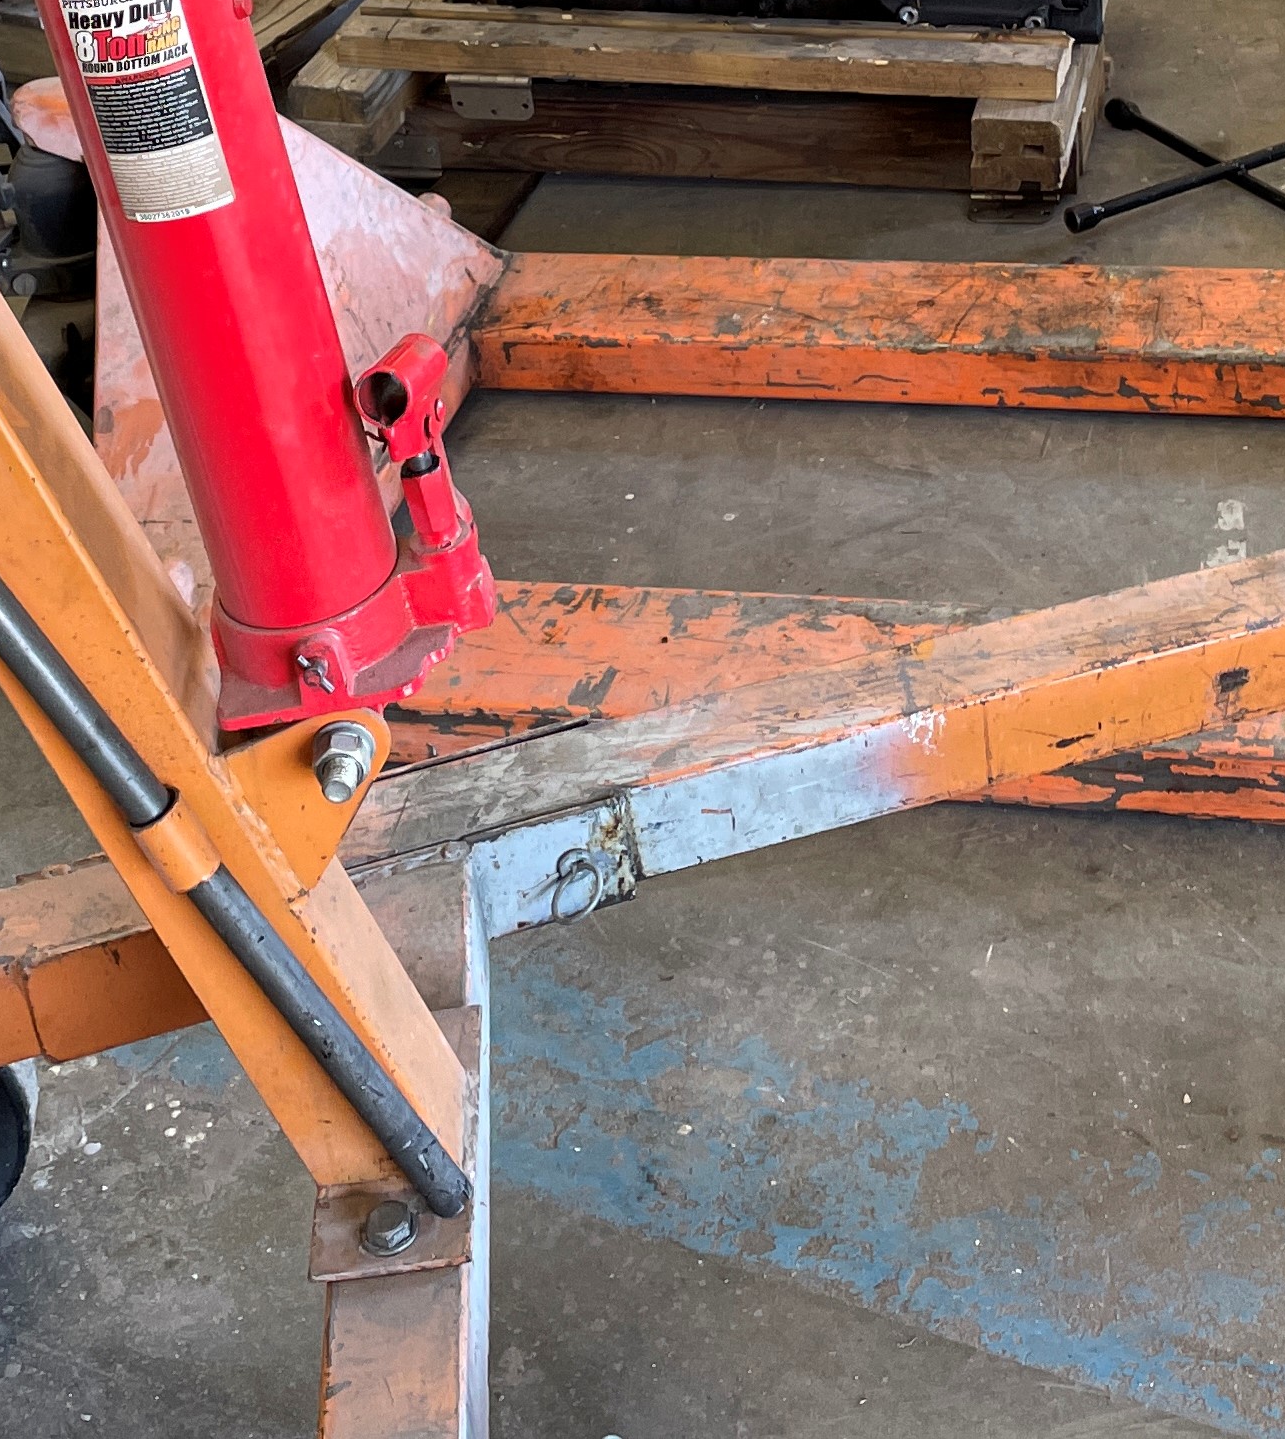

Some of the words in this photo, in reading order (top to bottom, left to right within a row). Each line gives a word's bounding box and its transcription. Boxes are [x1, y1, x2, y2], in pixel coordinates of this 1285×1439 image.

[69, 10, 125, 30] Heavy
[147, 33, 179, 54] RAM
[82, 62, 114, 73] ROUND
[116, 54, 161, 72] BOTTOM
[163, 44, 189, 62] JACK
